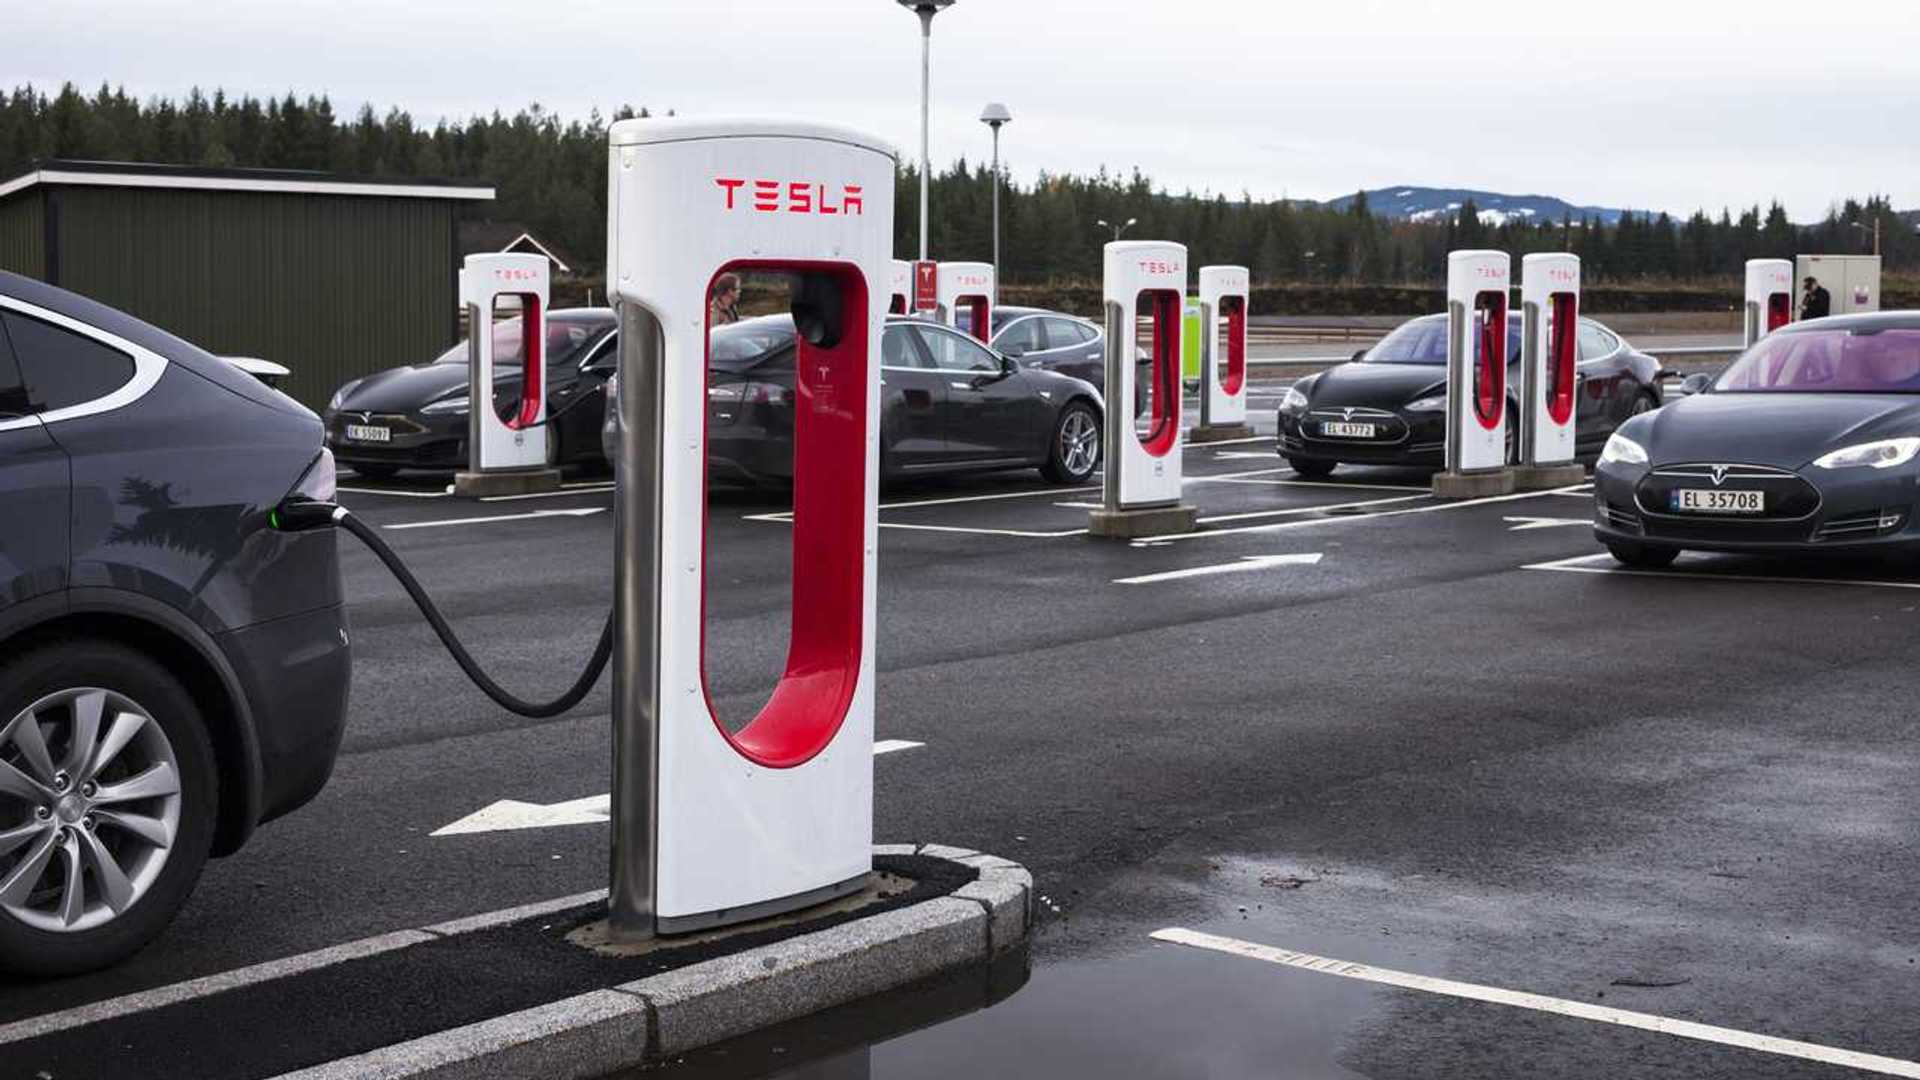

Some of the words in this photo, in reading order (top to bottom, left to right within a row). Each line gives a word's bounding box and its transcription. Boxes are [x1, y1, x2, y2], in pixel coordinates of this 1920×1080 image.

[715, 178, 863, 215] TESLA
[495, 269, 537, 280] TESLA
[1139, 262, 1181, 274] TESLA
[1684, 491, 1700, 507] EL
[1708, 492, 1758, 508] 35708
